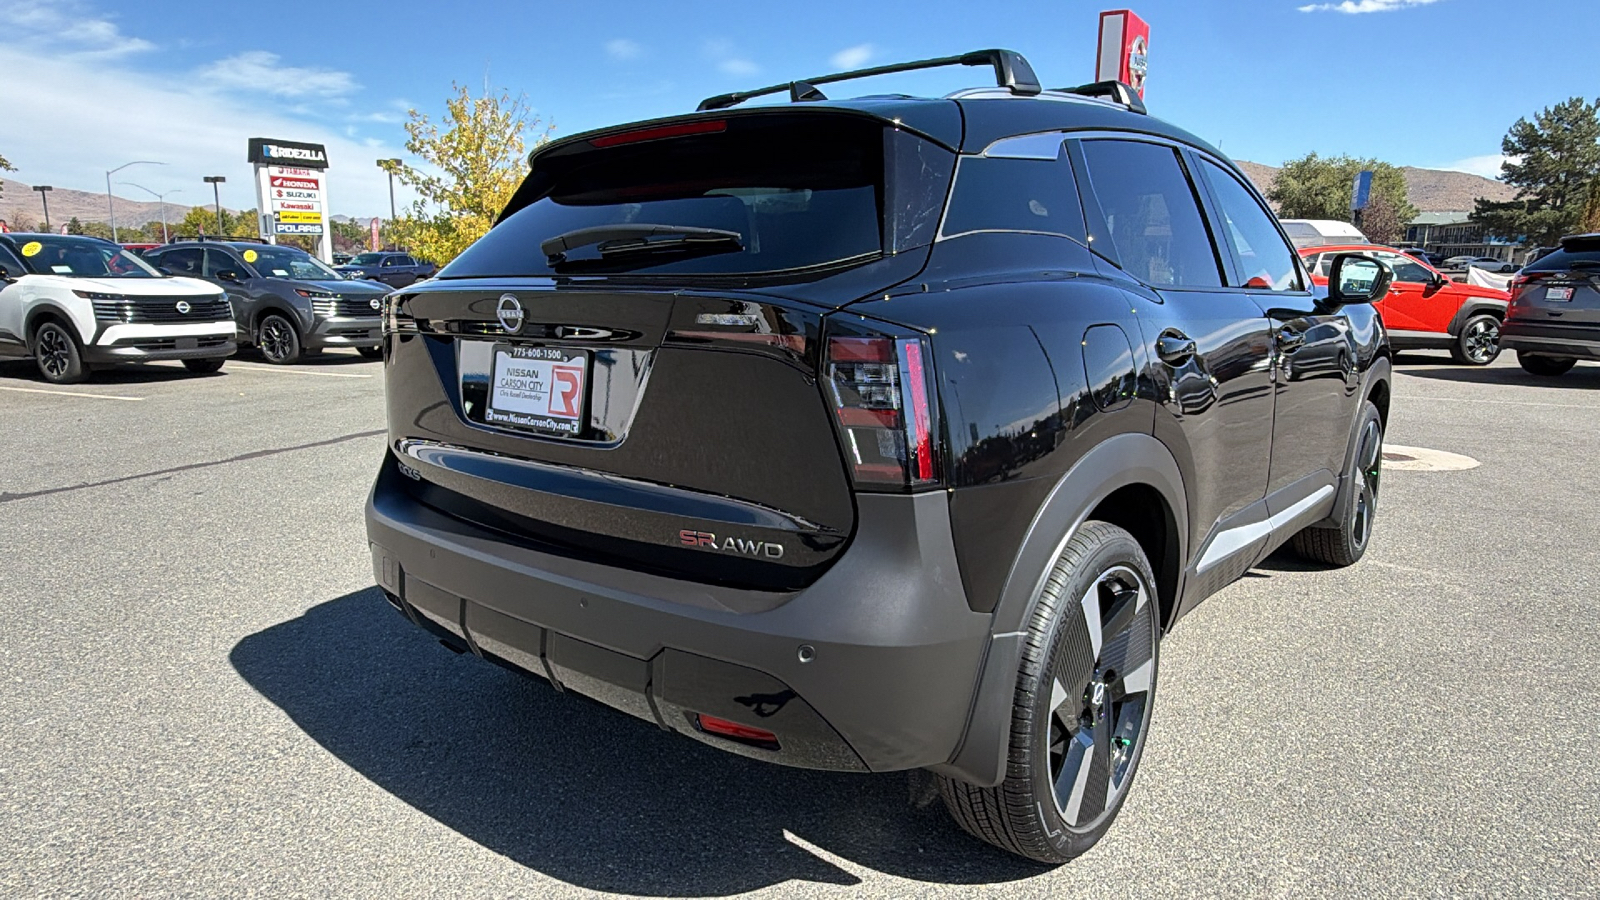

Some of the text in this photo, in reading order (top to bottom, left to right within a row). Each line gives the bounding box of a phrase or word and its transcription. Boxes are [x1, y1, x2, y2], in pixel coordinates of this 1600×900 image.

[278, 147, 325, 161] RIDEZILLA
[282, 180, 317, 189] HONDA
[280, 201, 314, 210] Kawasaki
[277, 224, 322, 233] POLARIS
[513, 347, 562, 359] 775-600-1500
[506, 367, 539, 379] NISSAN
[500, 377, 544, 391] CARSON CITY
[499, 389, 509, 397] Chris
[521, 391, 542, 402] Dealership
[493, 413, 571, 431] www.NissanCarsonCity.com
[680, 529, 784, 559] SR AWD
